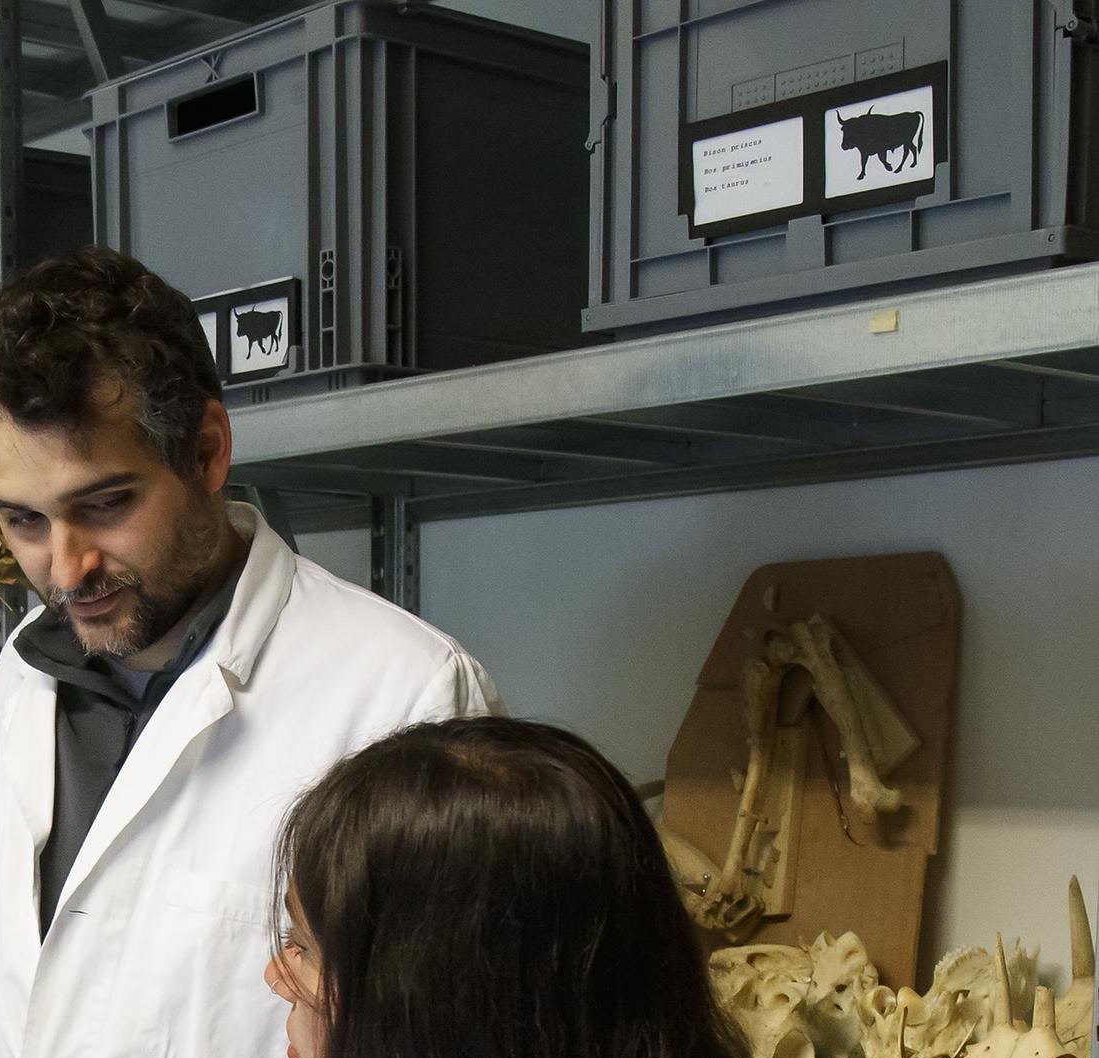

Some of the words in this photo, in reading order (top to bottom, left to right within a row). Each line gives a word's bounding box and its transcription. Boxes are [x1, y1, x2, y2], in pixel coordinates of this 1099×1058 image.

[703, 147, 726, 157] Bison
[730, 139, 762, 153] priscus
[704, 167, 717, 175] Bos
[722, 155, 772, 173] primigenius
[704, 185, 717, 193] Bos
[721, 179, 749, 190] taurus
